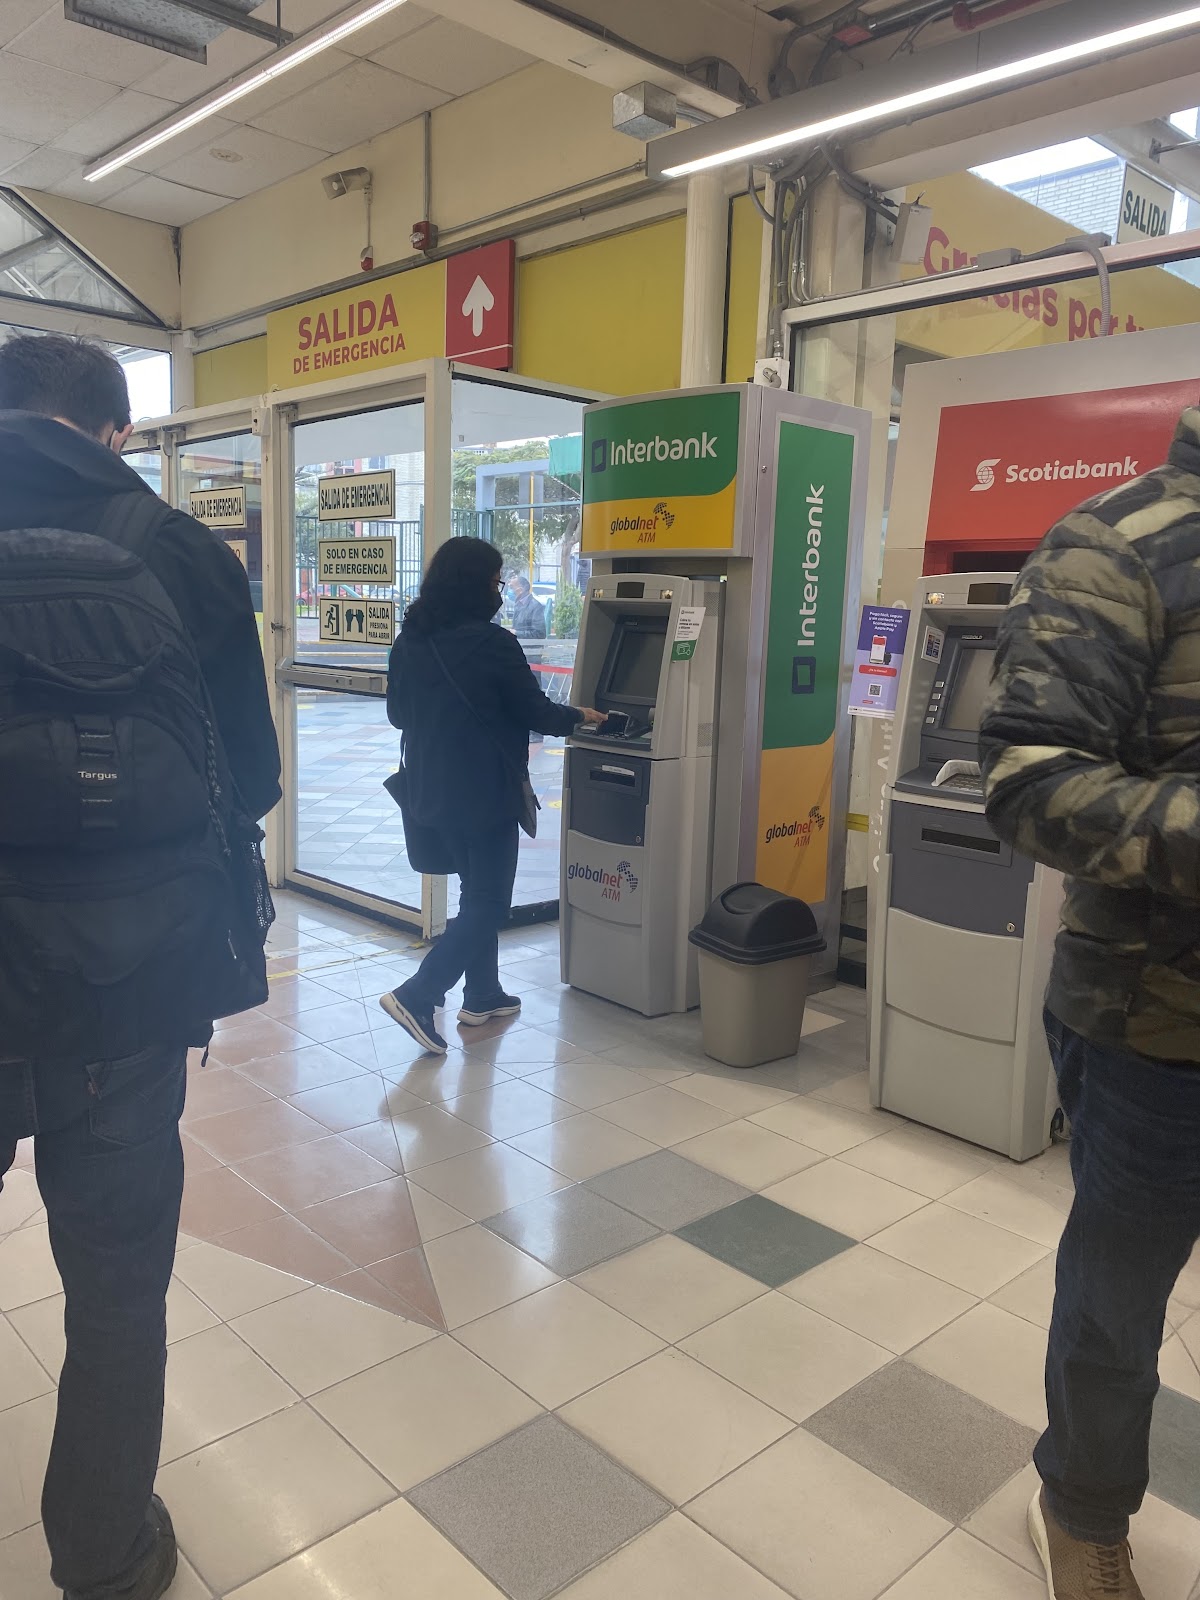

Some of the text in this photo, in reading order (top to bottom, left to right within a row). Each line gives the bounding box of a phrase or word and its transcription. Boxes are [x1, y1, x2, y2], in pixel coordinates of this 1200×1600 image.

[1123, 189, 1167, 237] SALIDA
[923, 226, 1059, 327] Grcias
[298, 293, 399, 350] SALIDA
[293, 333, 406, 375] DE EMERGENCIA
[610, 431, 718, 466] Interbank
[1005, 455, 1139, 483] Scotiabank
[191, 496, 243, 518] SALIDA DE EMERGENCIA
[320, 482, 390, 510] SALIDA DE EMERGENCIA
[610, 516, 659, 535] globalnet
[637, 532, 656, 543] ATM
[326, 547, 384, 559] SOLO EN CASO
[797, 483, 825, 646] Interbank
[323, 563, 388, 575] DE EMERGENCIA
[368, 606, 390, 620] SALIDA
[369, 621, 389, 630] PRESIONA
[77, 770, 118, 781] Targus
[765, 818, 813, 844] globalnet
[794, 835, 811, 848] ATM
[568, 862, 623, 888] globalnet
[601, 887, 621, 902] ATM
